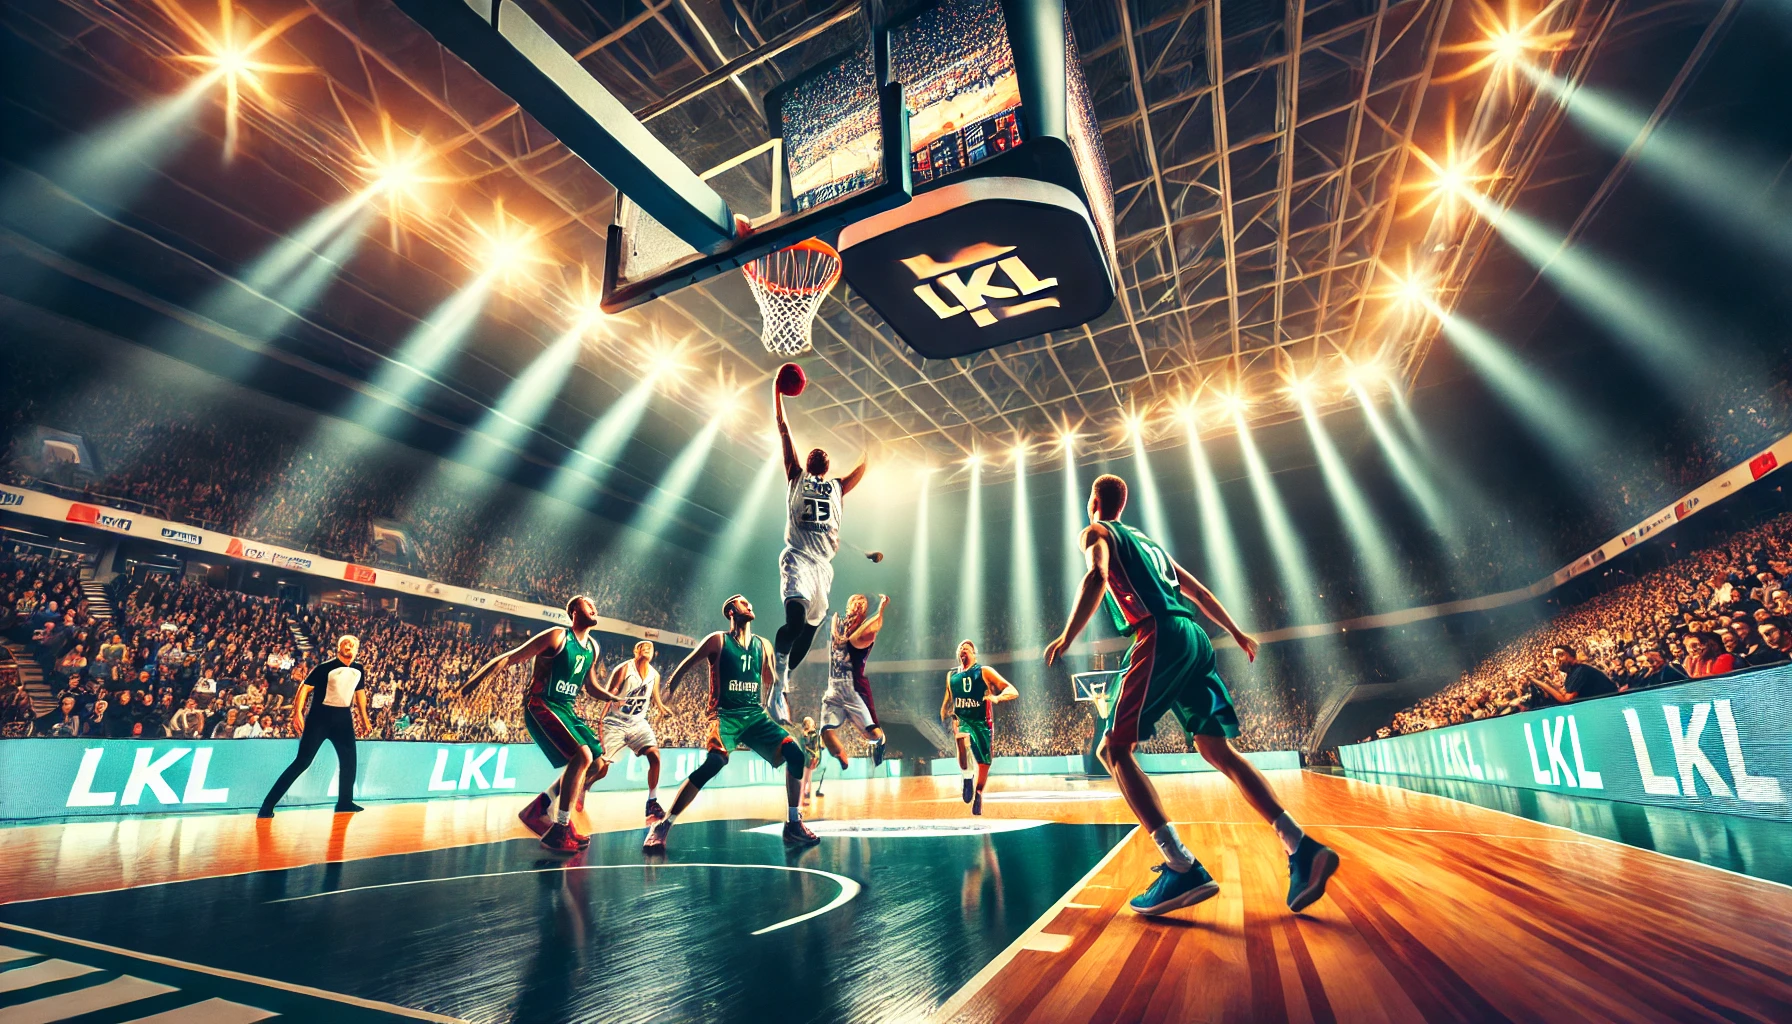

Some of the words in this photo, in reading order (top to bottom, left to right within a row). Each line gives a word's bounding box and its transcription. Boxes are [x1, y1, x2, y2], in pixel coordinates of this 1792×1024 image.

[913, 256, 1059, 322] LKL
[66, 746, 230, 807] LKL
[427, 746, 518, 791] LKL
[1523, 715, 1604, 789] LKL
[1622, 699, 1786, 804] LKL
